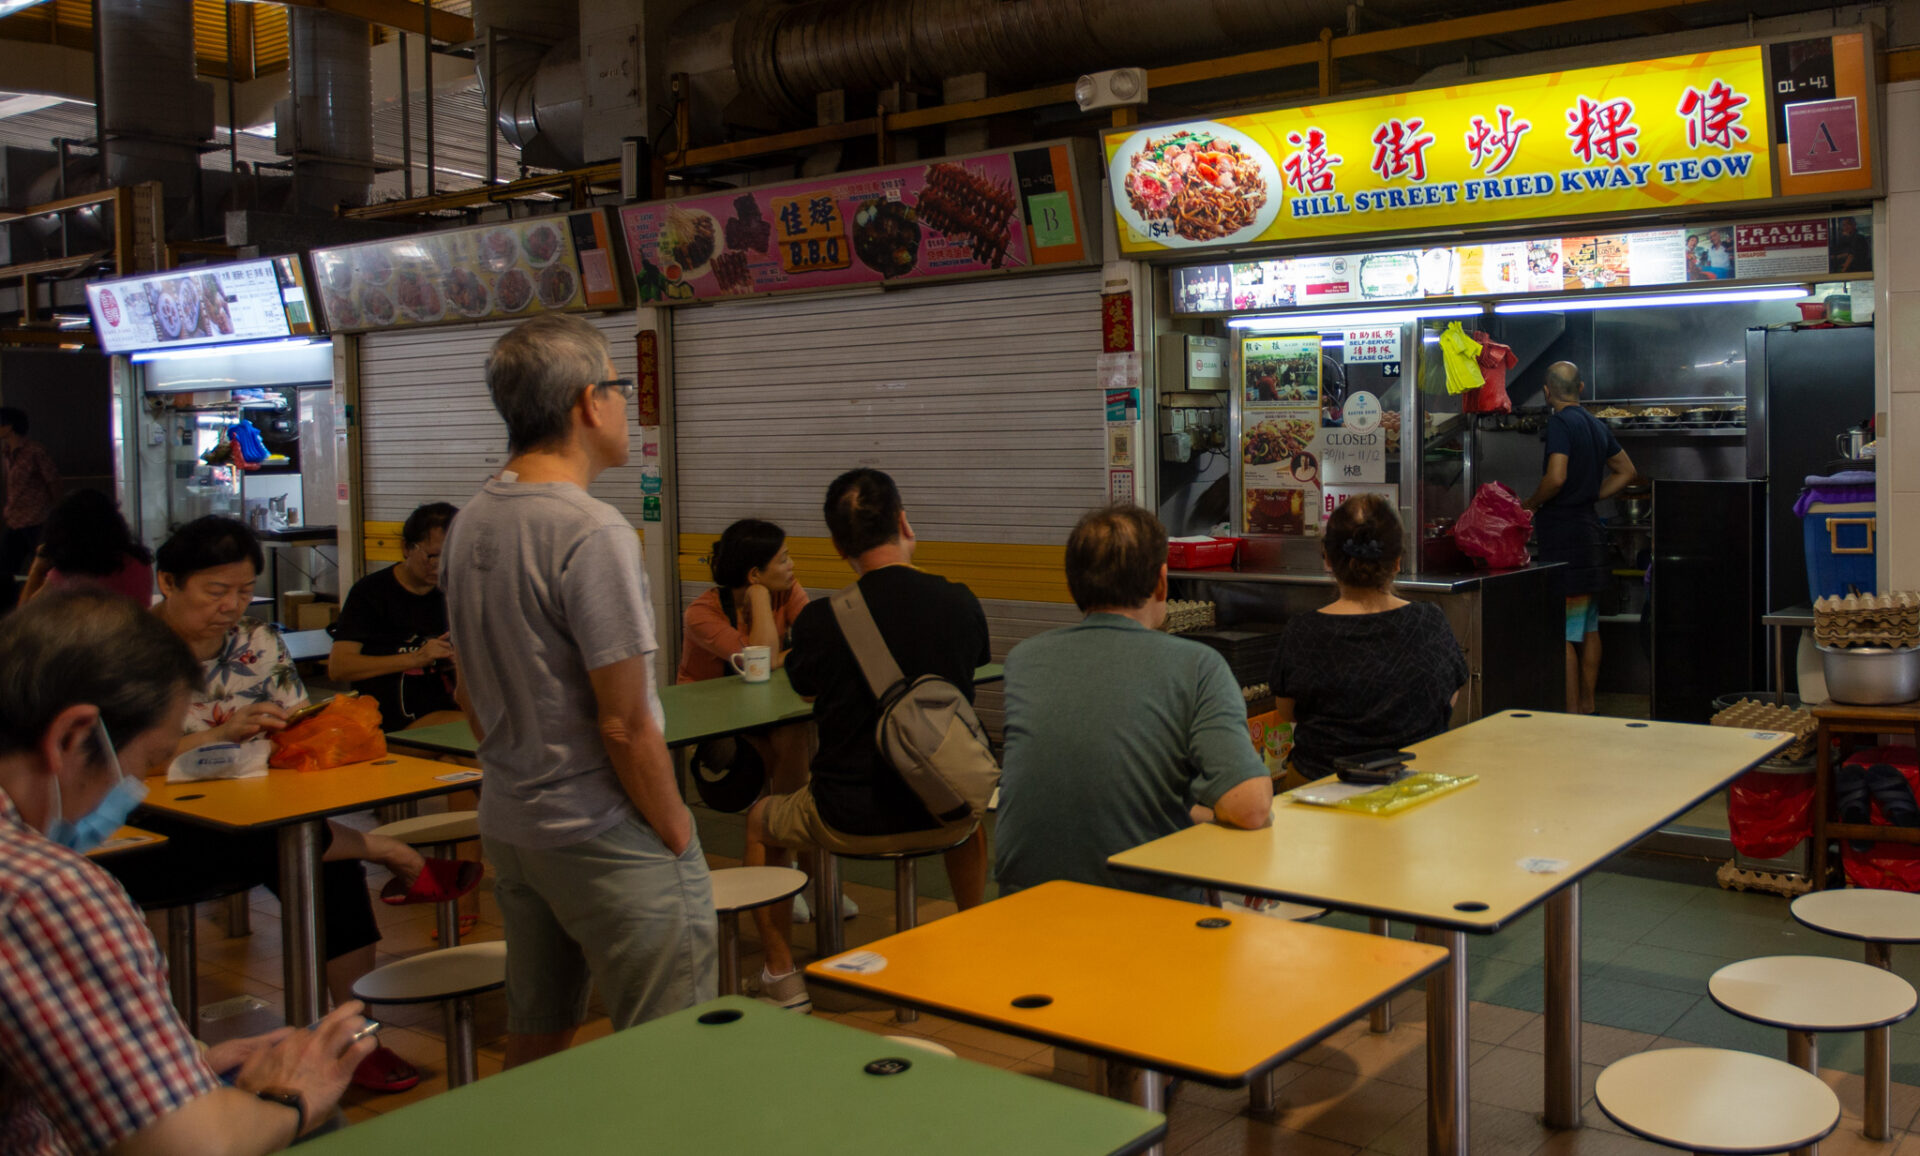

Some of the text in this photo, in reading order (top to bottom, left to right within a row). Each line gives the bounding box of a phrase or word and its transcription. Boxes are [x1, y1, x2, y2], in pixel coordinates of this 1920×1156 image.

[1808, 121, 1841, 155] A
[1291, 154, 1752, 217] HILL STREET FRIED KWAY TEOW
[1043, 207, 1060, 231] B
[1737, 224, 1827, 237] TRAVEL
[1738, 233, 1827, 245] +LEISURE
[1326, 433, 1377, 446] CLOSED
[1343, 464, 1362, 477] 休息
